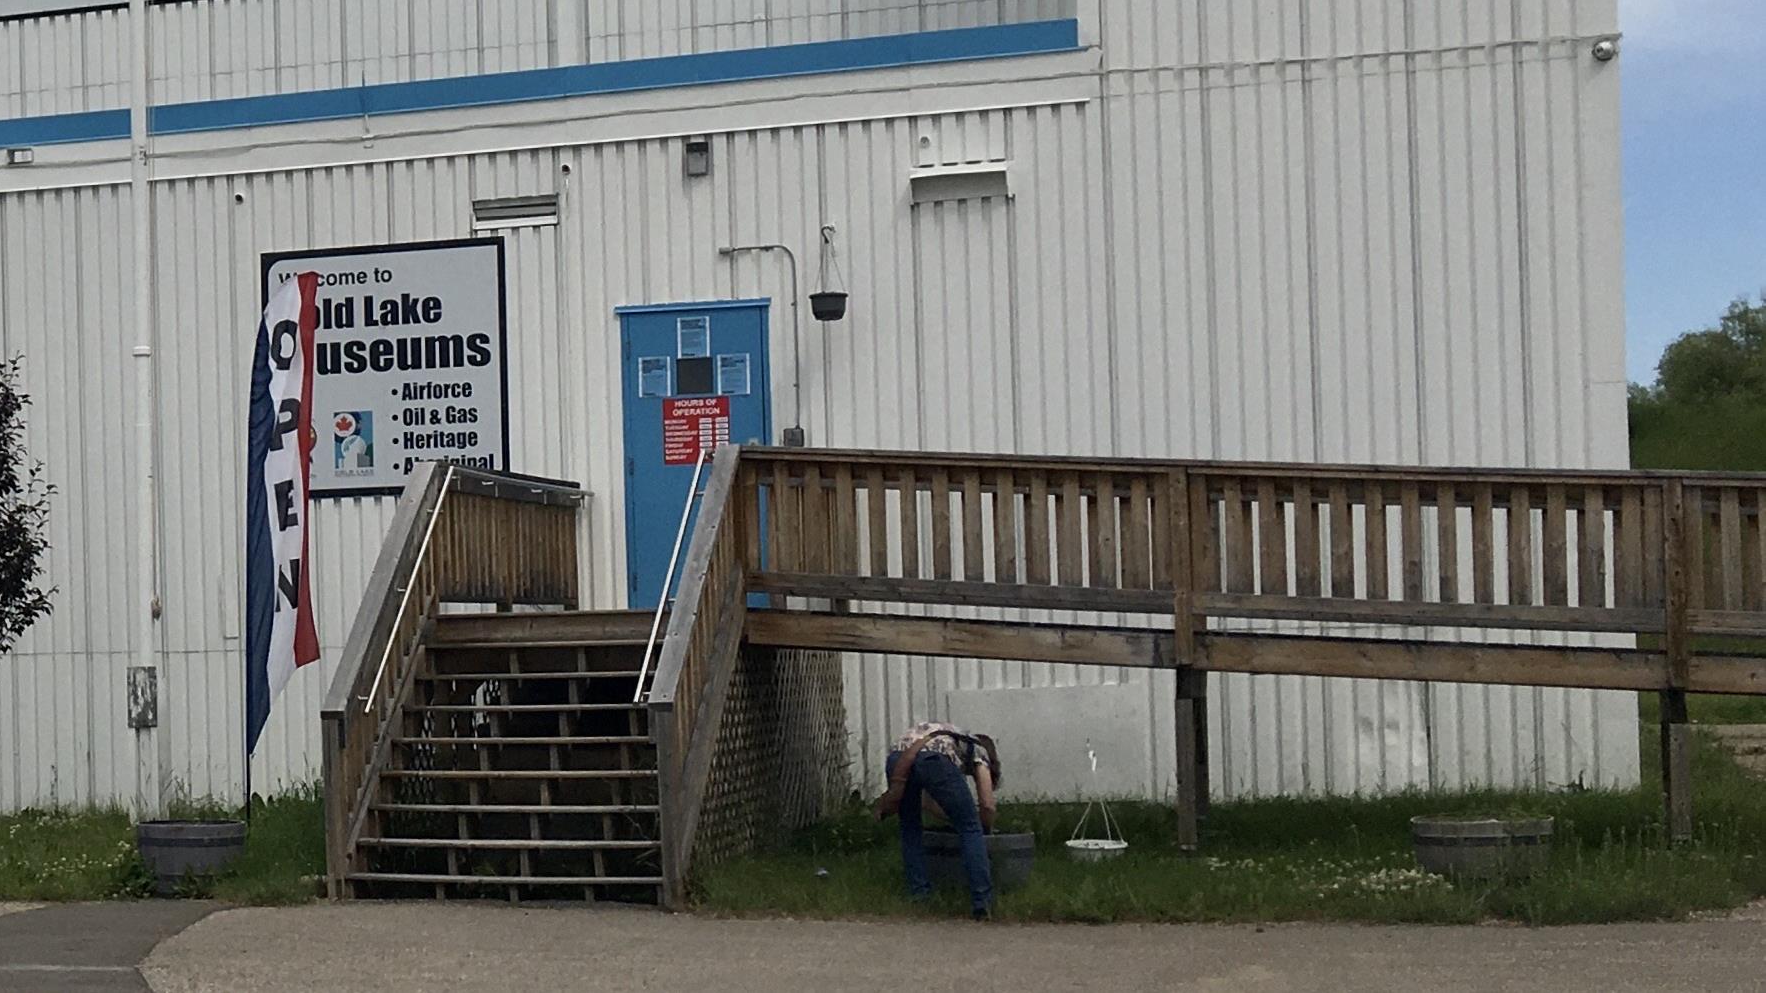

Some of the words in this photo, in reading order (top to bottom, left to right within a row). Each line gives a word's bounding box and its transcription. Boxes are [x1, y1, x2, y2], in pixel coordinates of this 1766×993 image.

[374, 267, 393, 284] to
[363, 293, 443, 328] Lake
[316, 332, 492, 376] useums
[401, 380, 473, 401] Airforce
[672, 407, 721, 417] OPERATION
[674, 399, 704, 407] HOURS
[705, 397, 718, 407] OF
[402, 407, 426, 426] Oil
[429, 408, 442, 425] &
[445, 406, 478, 425] Gas
[403, 430, 478, 451] Heritage
